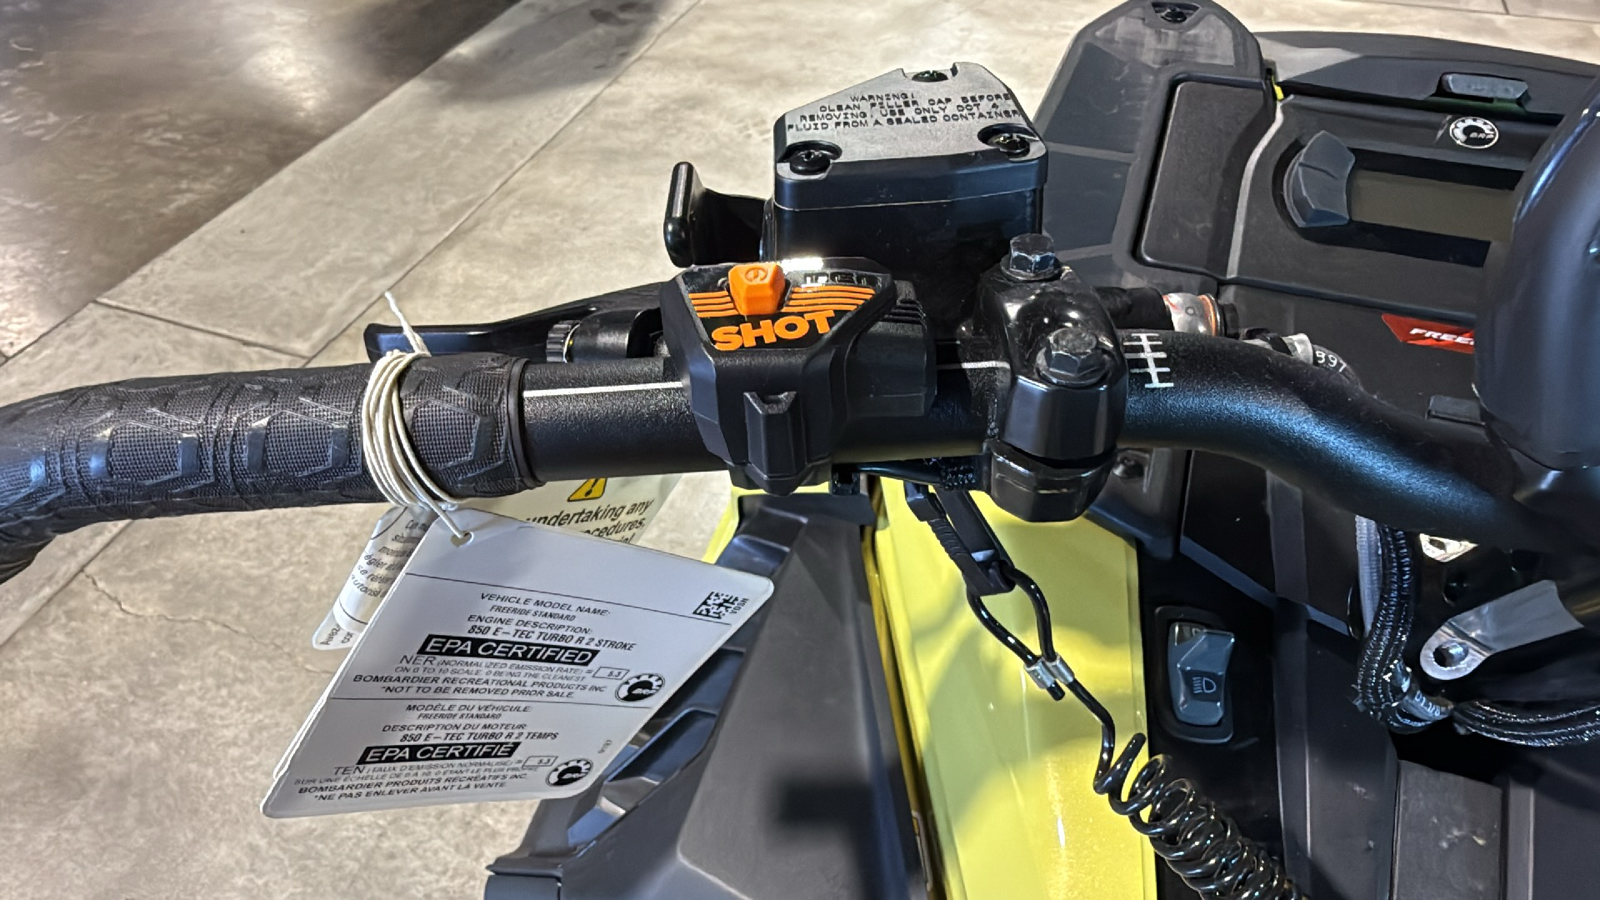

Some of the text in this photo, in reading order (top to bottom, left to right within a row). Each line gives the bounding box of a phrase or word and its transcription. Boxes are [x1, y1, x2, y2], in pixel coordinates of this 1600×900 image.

[870, 100, 919, 109] FILLER
[927, 97, 952, 106] CAP
[961, 93, 1011, 103] BEFORE
[880, 109, 905, 117] USE
[914, 106, 946, 115] ONLY
[956, 102, 981, 111] DOT
[787, 109, 1021, 131] FLUID FROM A SEALED CONTAINER
[711, 310, 835, 351] SHOT
[1409, 327, 1474, 345] FREE
[626, 498, 655, 515] any
[480, 593, 611, 616] VEHICLE MODEL NAME:
[490, 605, 577, 621] FREERIDE STANDARD
[467, 614, 593, 634] ENGINE DESCRIPTION:
[467, 625, 490, 635] 850
[537, 631, 574, 644] TURBO
[575, 637, 585, 645] R
[585, 637, 594, 646] 2
[595, 639, 637, 651] STROKE
[425, 637, 593, 663] EPA CERTIFIED
[400, 655, 436, 666] NER
[509, 663, 555, 673] EMISSION
[607, 670, 622, 678] 5.3
[353, 674, 440, 684] BOMBARDIER
[442, 677, 529, 688] RECREATIONAL
[531, 681, 588, 690] PRODUCTS
[541, 673, 586, 682] CLEANEST
[453, 687, 510, 696] REMOVED
[512, 689, 538, 697] PRIOR
[406, 703, 455, 712] MODÈLE
[382, 724, 460, 732] DESCRIPTION
[400, 733, 422, 742] 850
[467, 732, 503, 740] TURBO
[504, 732, 513, 740] R
[515, 732, 523, 740] 2
[525, 732, 559, 740] TEMPS
[366, 742, 514, 762] EPA CERTIFIÉ
[334, 766, 366, 775] TEN
[298, 782, 385, 794] BOMBARDIER
[385, 778, 443, 787] PRODUITS
[338, 792, 362, 800] PAS
[365, 787, 419, 797] ENLEVER
[420, 784, 457, 792] AVANT
